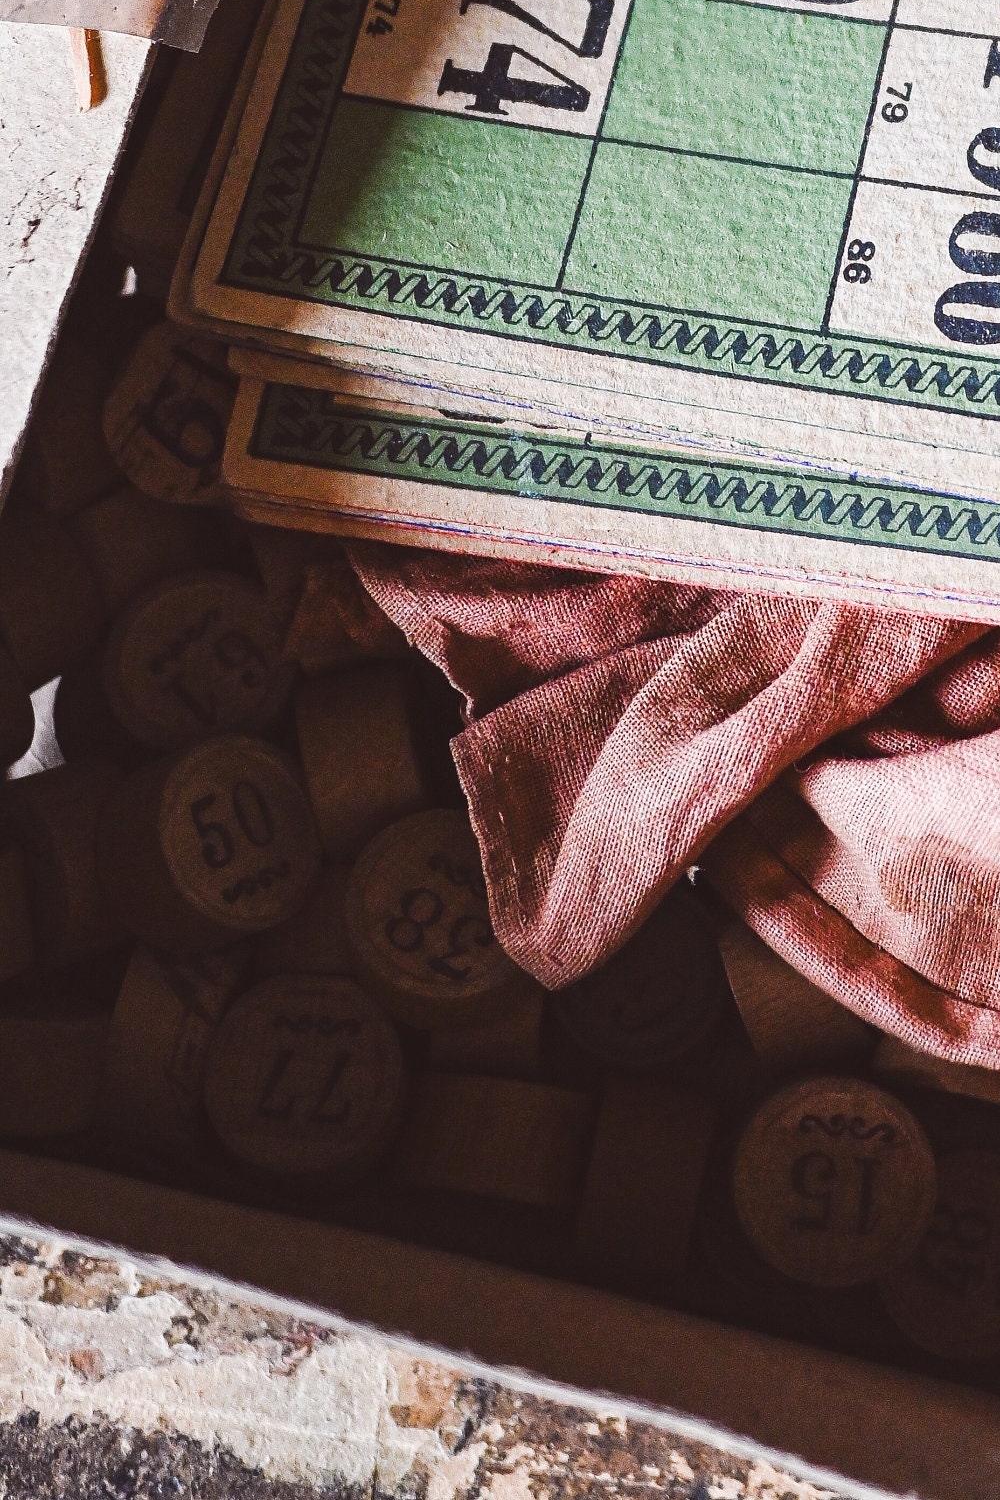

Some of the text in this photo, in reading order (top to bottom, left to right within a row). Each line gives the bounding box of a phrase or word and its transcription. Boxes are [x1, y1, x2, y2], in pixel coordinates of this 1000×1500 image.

[880, 80, 913, 125] 79
[842, 237, 877, 285] 86
[190, 781, 275, 869] 50
[790, 1150, 879, 1236] 15
